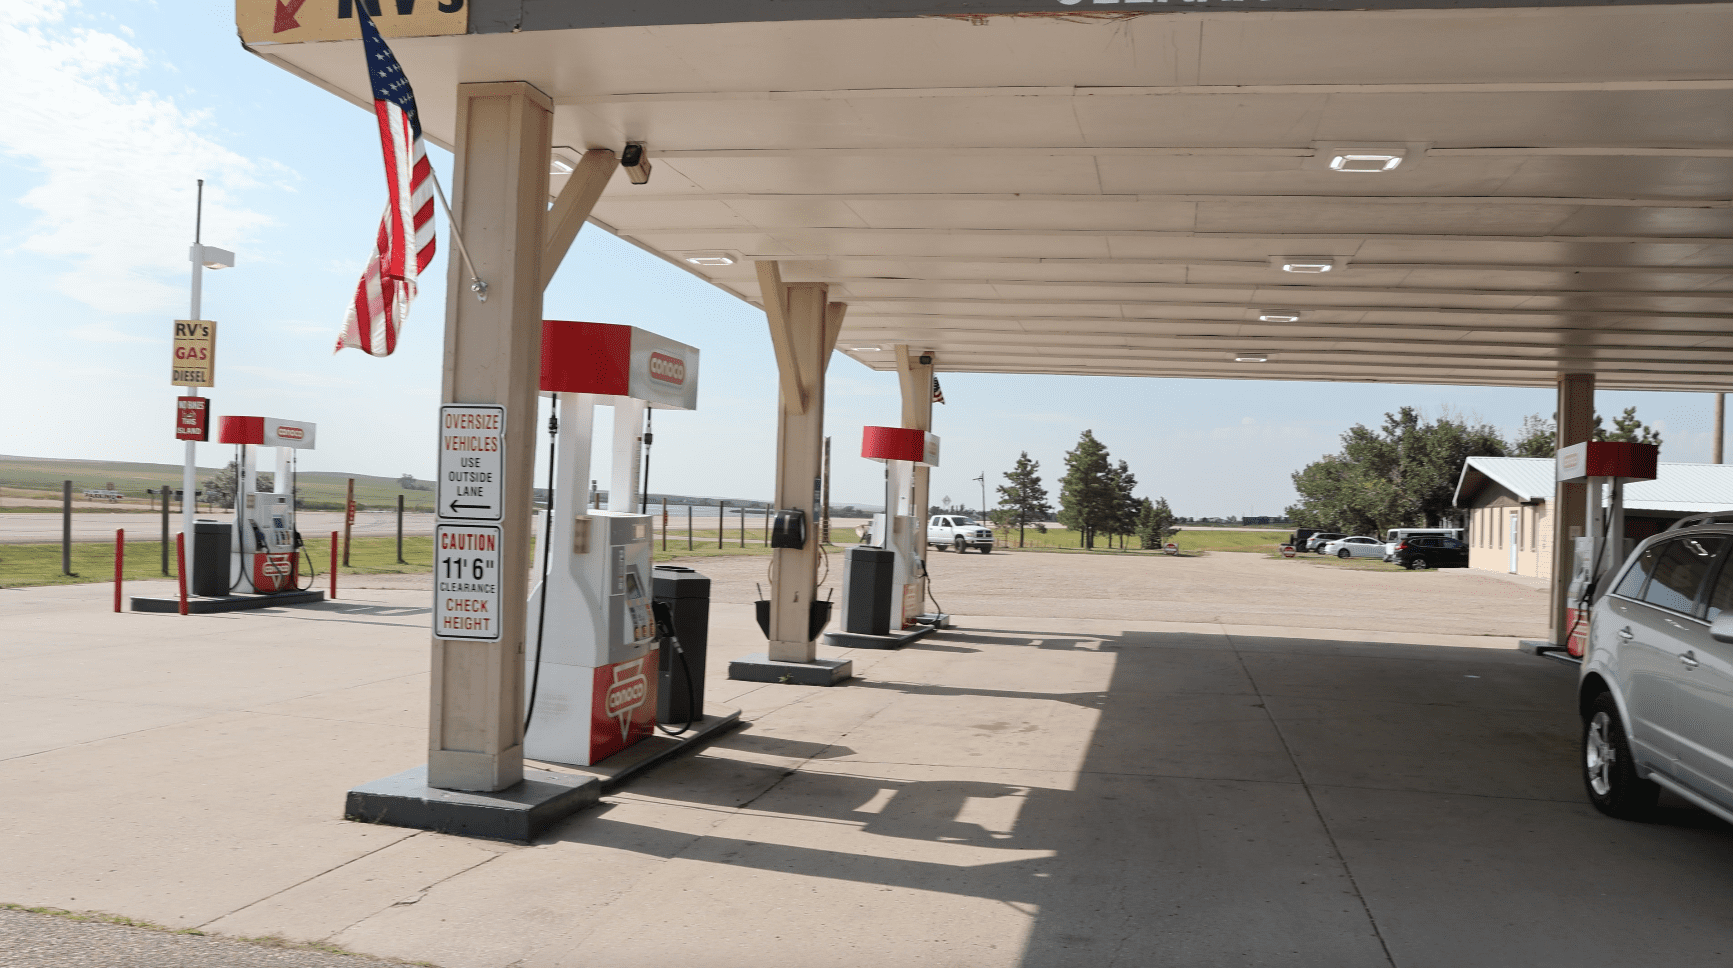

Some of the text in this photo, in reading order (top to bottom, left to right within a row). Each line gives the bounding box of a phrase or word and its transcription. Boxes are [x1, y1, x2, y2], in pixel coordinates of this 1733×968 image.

[176, 323, 209, 337] RV's
[175, 347, 207, 360] GAS
[173, 370, 206, 382] DIESEL
[651, 358, 685, 380] conoco
[445, 413, 499, 429] OVERSIZE
[444, 435, 498, 452] VEHICLES
[460, 457, 481, 468] USE
[448, 471, 493, 483] OUTSIDE
[456, 486, 484, 497] LANE
[441, 532, 496, 552] CAUTION
[440, 582, 496, 594] CLEARANCE
[446, 598, 489, 613] CHECK
[443, 616, 491, 631] HEIGHT
[610, 683, 645, 707] conoco
